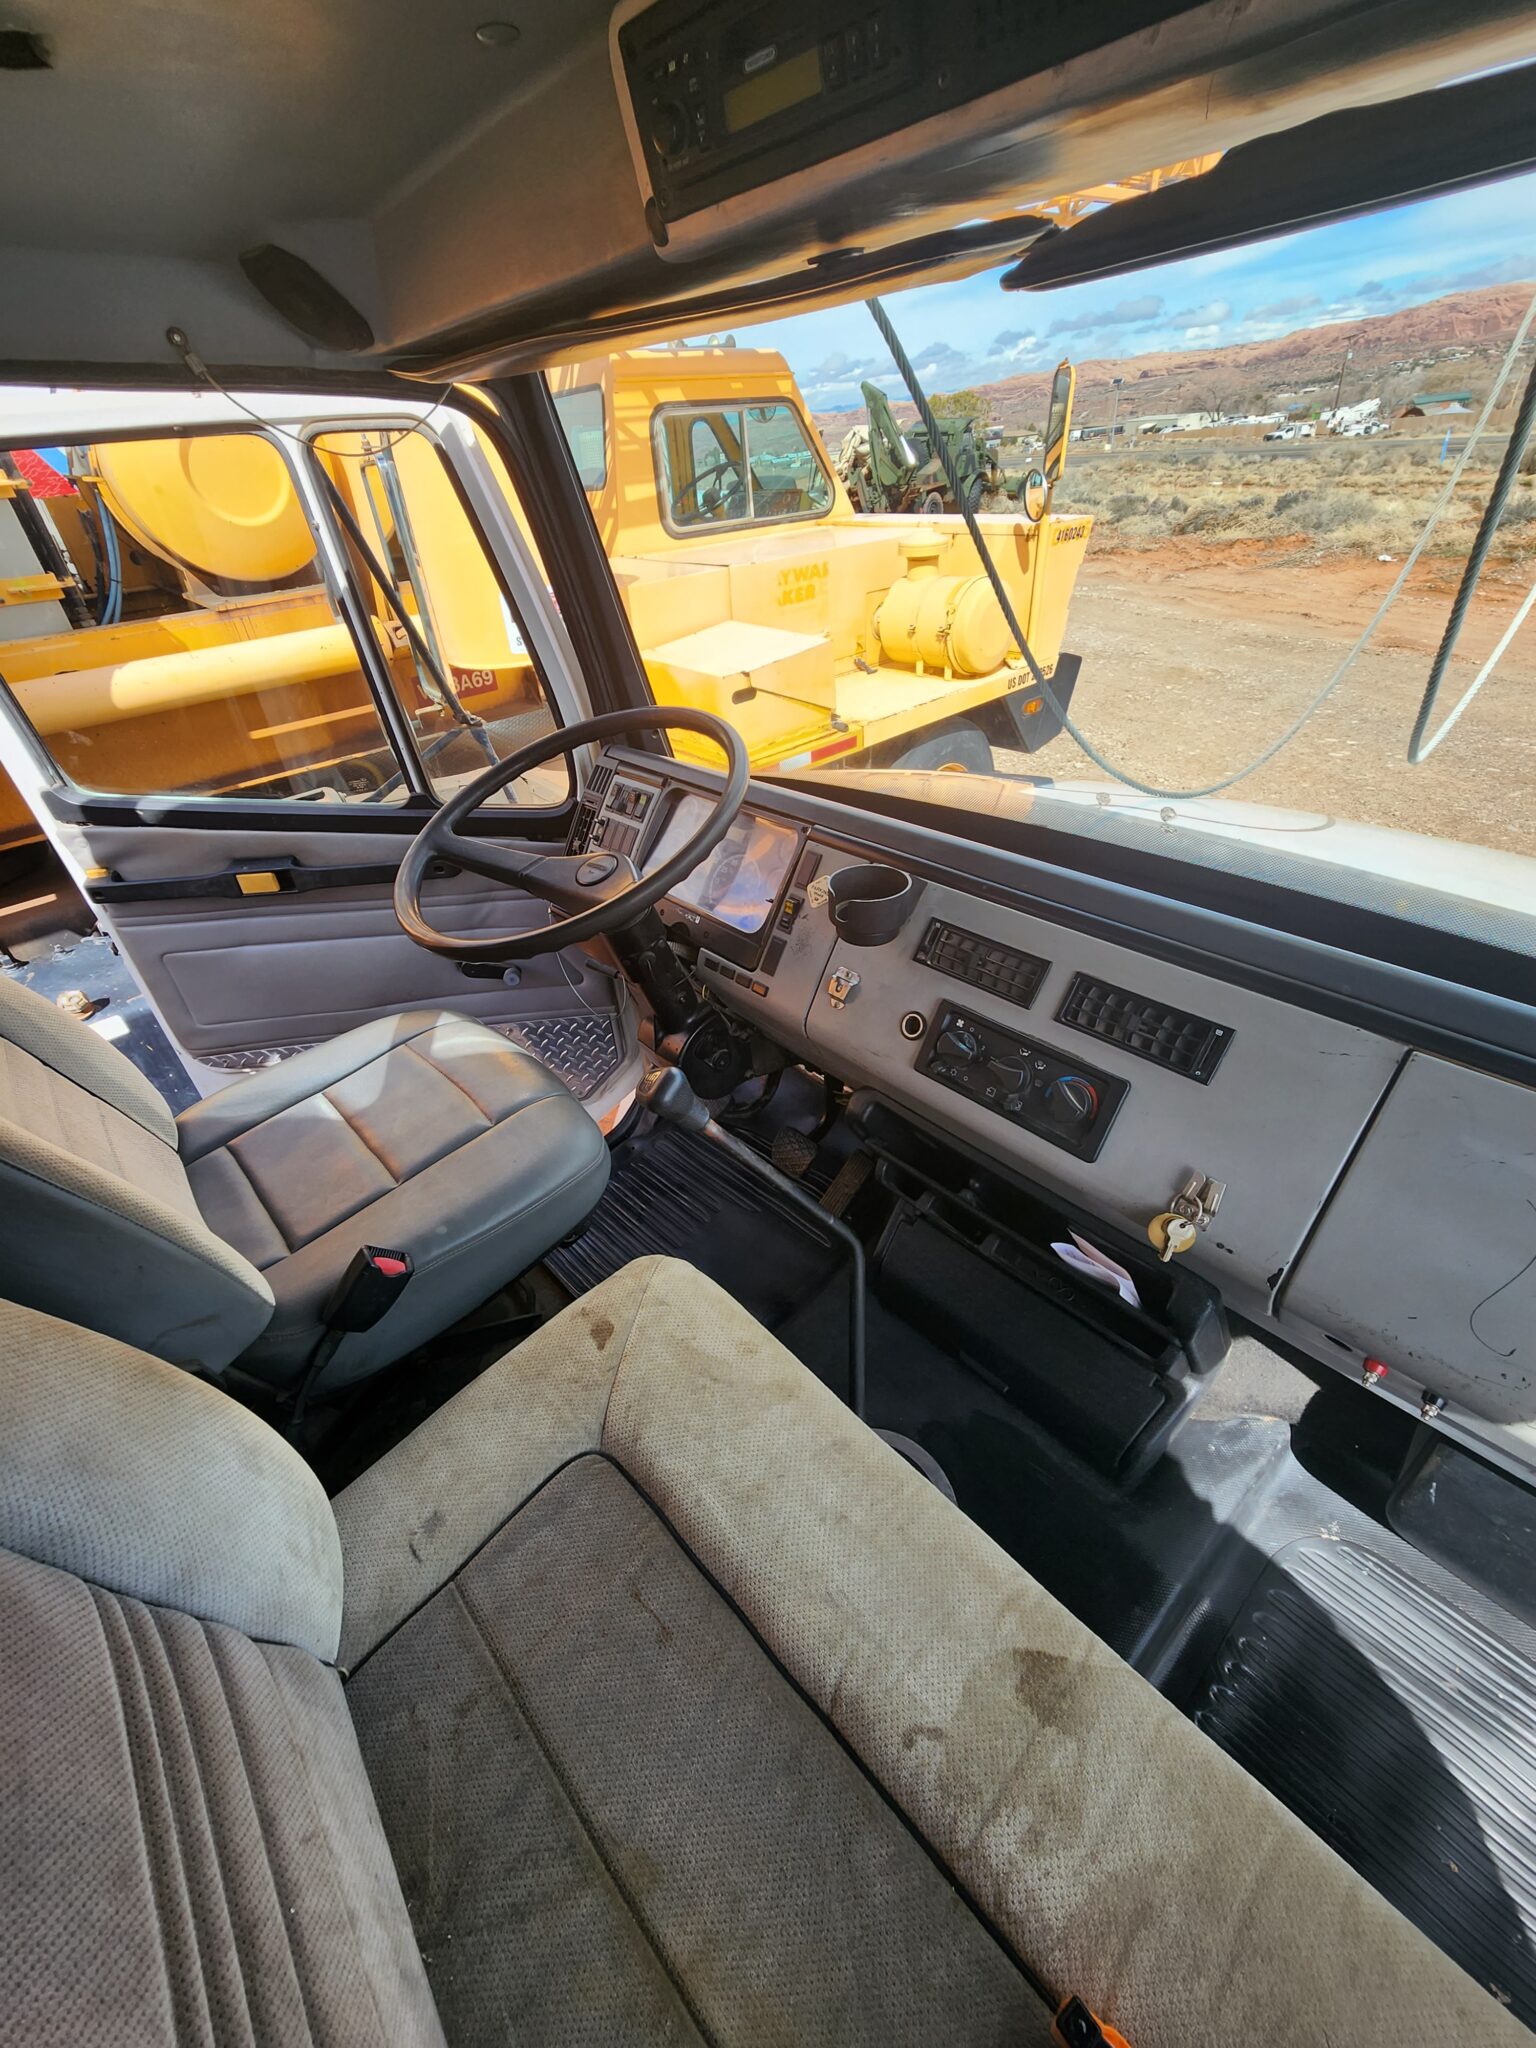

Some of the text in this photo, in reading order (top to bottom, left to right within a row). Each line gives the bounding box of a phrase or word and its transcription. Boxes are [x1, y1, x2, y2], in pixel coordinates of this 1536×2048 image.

[1056, 525, 1086, 543] 4160243
[1007, 677, 1017, 690] US
[1017, 672, 1031, 686] DOT
